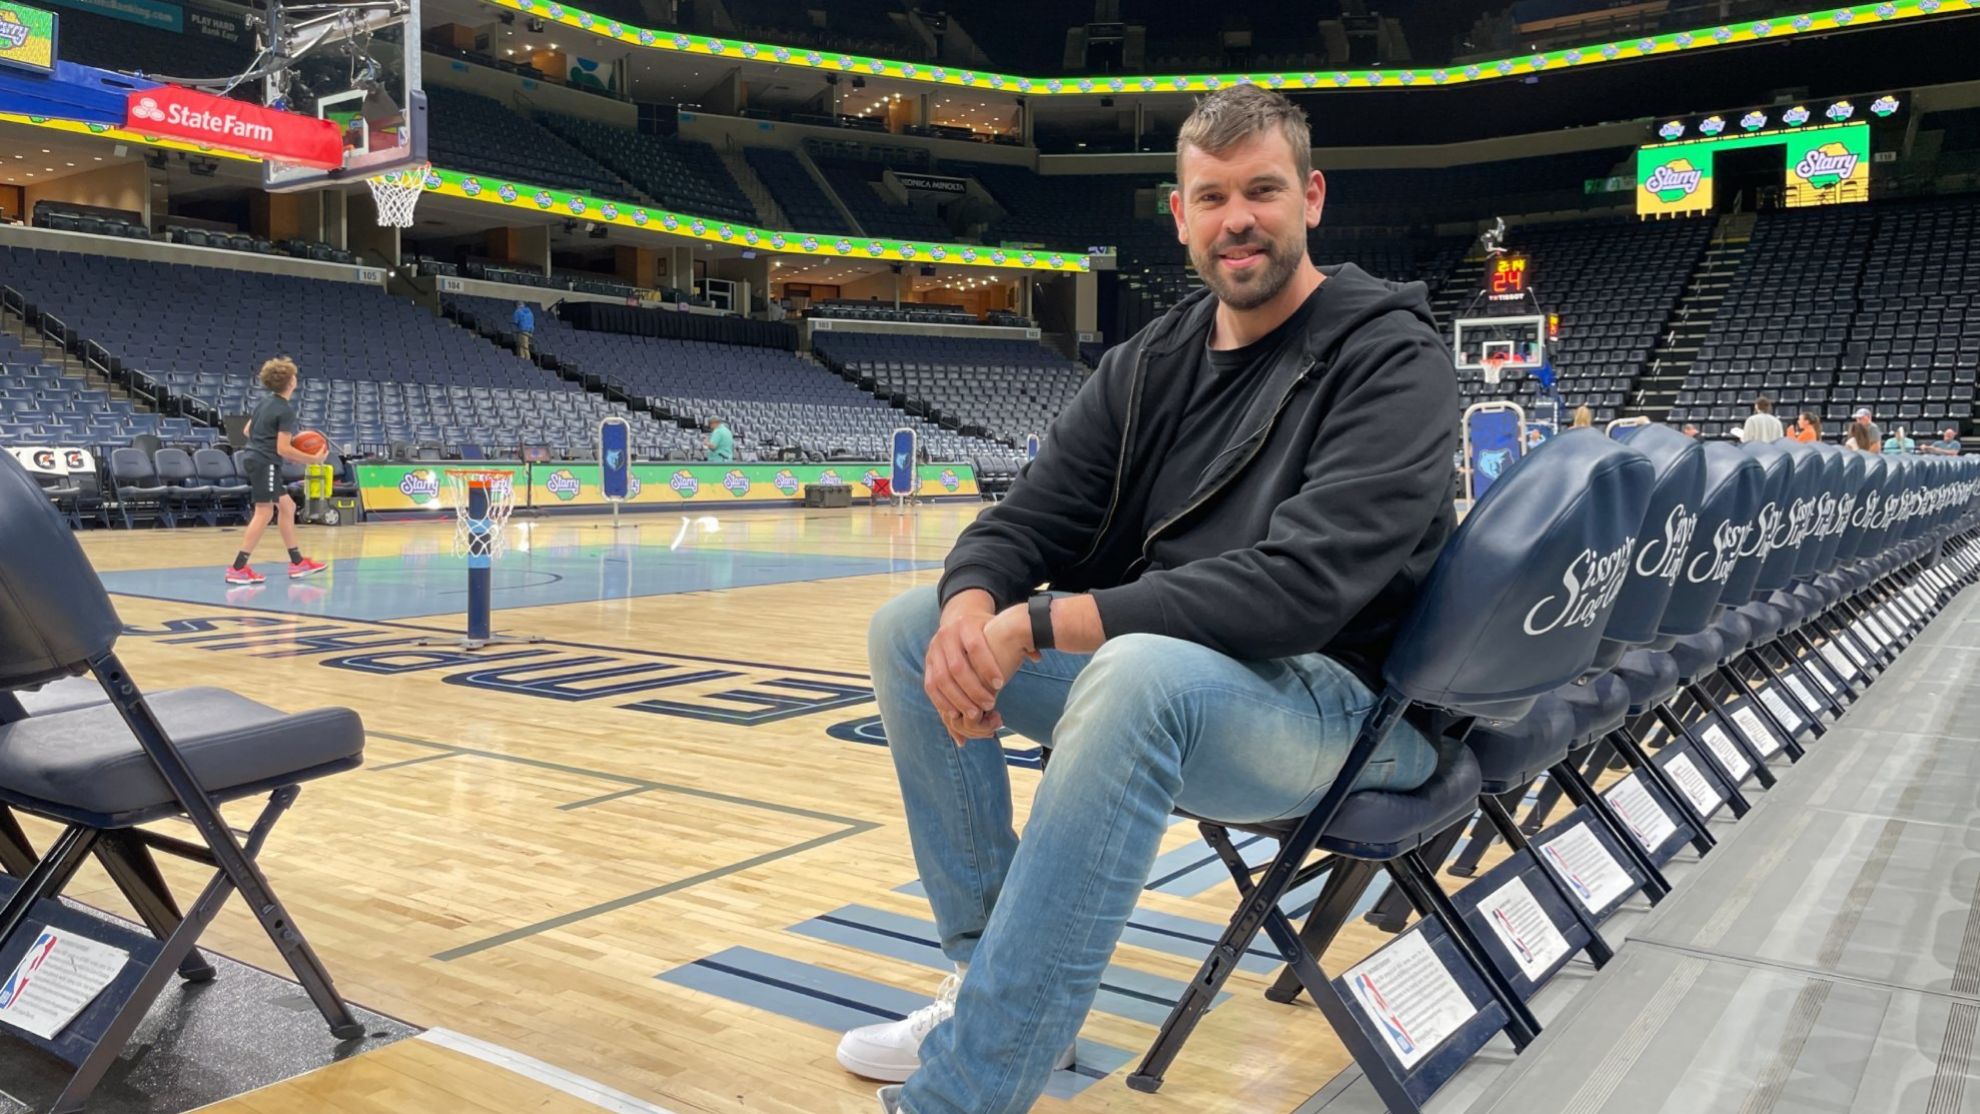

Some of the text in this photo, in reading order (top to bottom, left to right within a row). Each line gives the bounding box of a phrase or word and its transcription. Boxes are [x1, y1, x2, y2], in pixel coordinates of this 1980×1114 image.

[191, 14, 235, 32] PLAY HARD
[1796, 150, 1858, 179] Starry
[932, 180, 965, 191] MINOLTA
[1646, 165, 1702, 193] Starry
[363, 271, 377, 280] 105
[1494, 272, 1521, 292] 24
[400, 474, 440, 497] Starry
[547, 474, 580, 495] Starry
